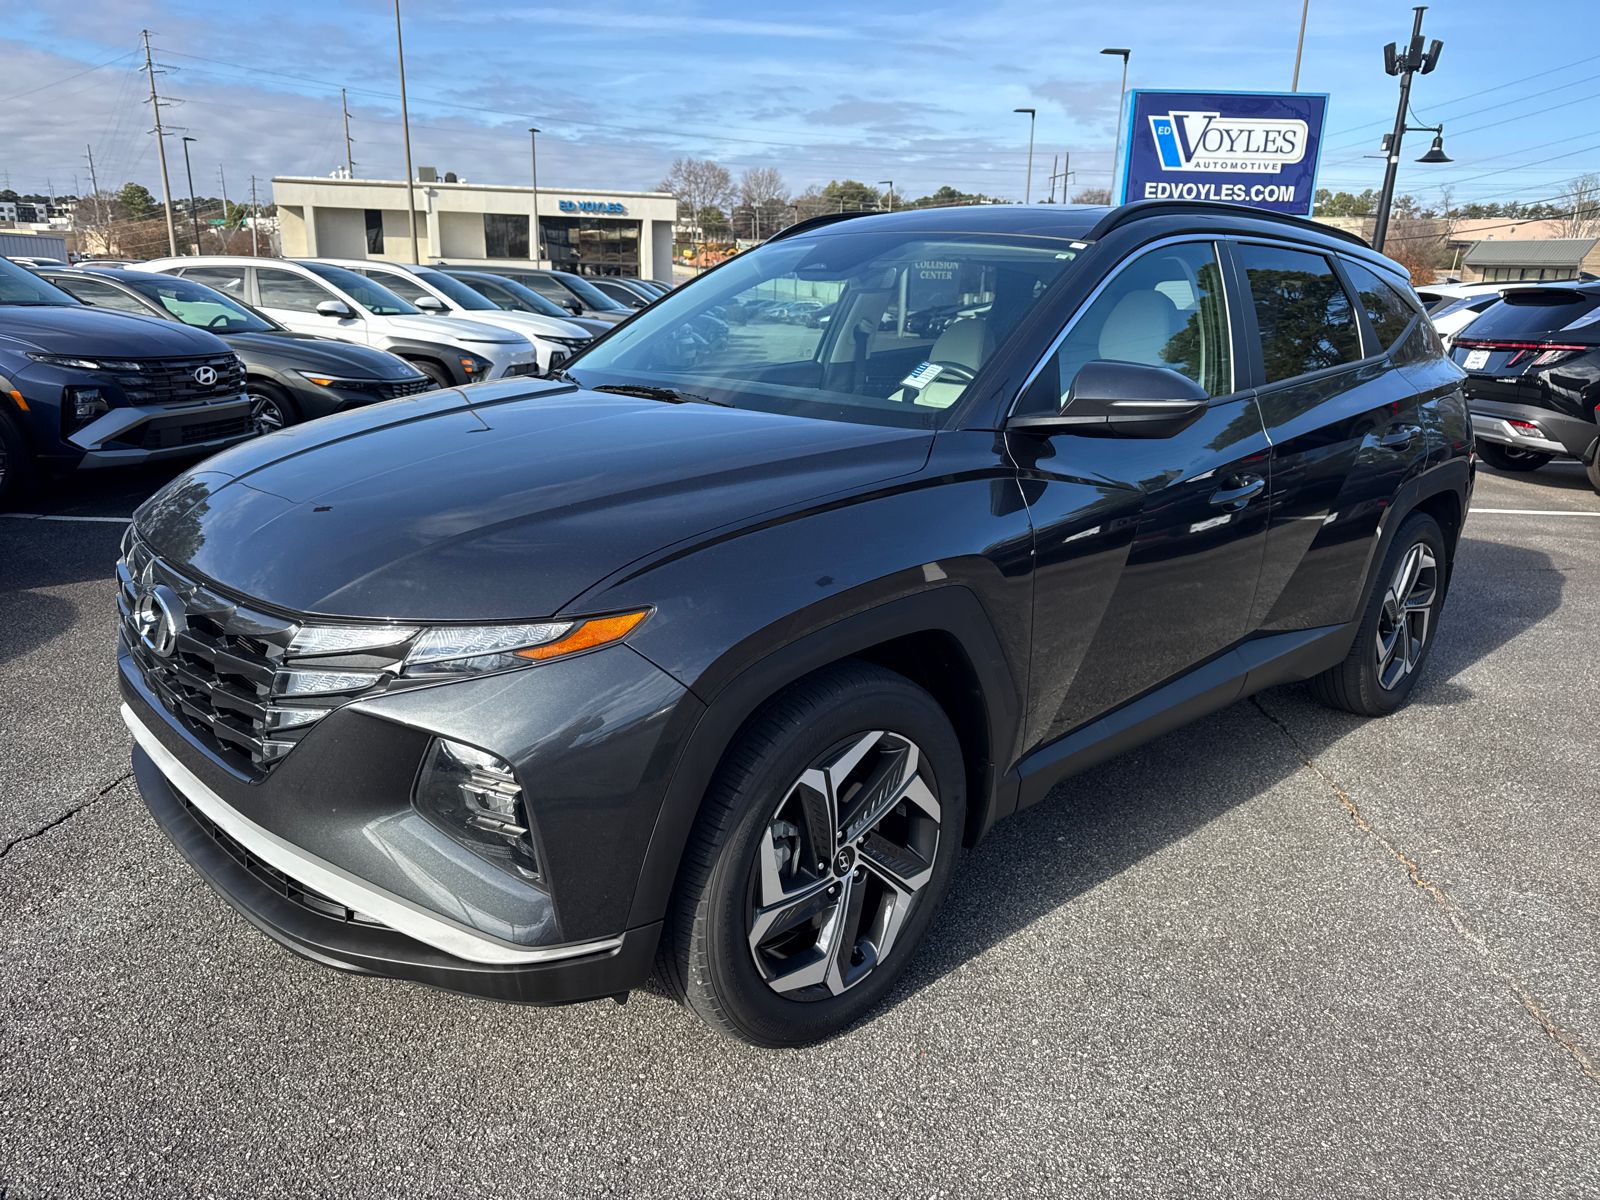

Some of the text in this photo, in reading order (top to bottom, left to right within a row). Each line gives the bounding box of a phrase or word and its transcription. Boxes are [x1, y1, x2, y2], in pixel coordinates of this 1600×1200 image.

[1158, 115, 1297, 163] ED VOYLES
[1195, 162, 1278, 170] AUTOMOTIVE
[1145, 183, 1295, 201] EDVOYLES.COM
[559, 200, 623, 213] ED VOYLES
[921, 271, 952, 279] CENTER
